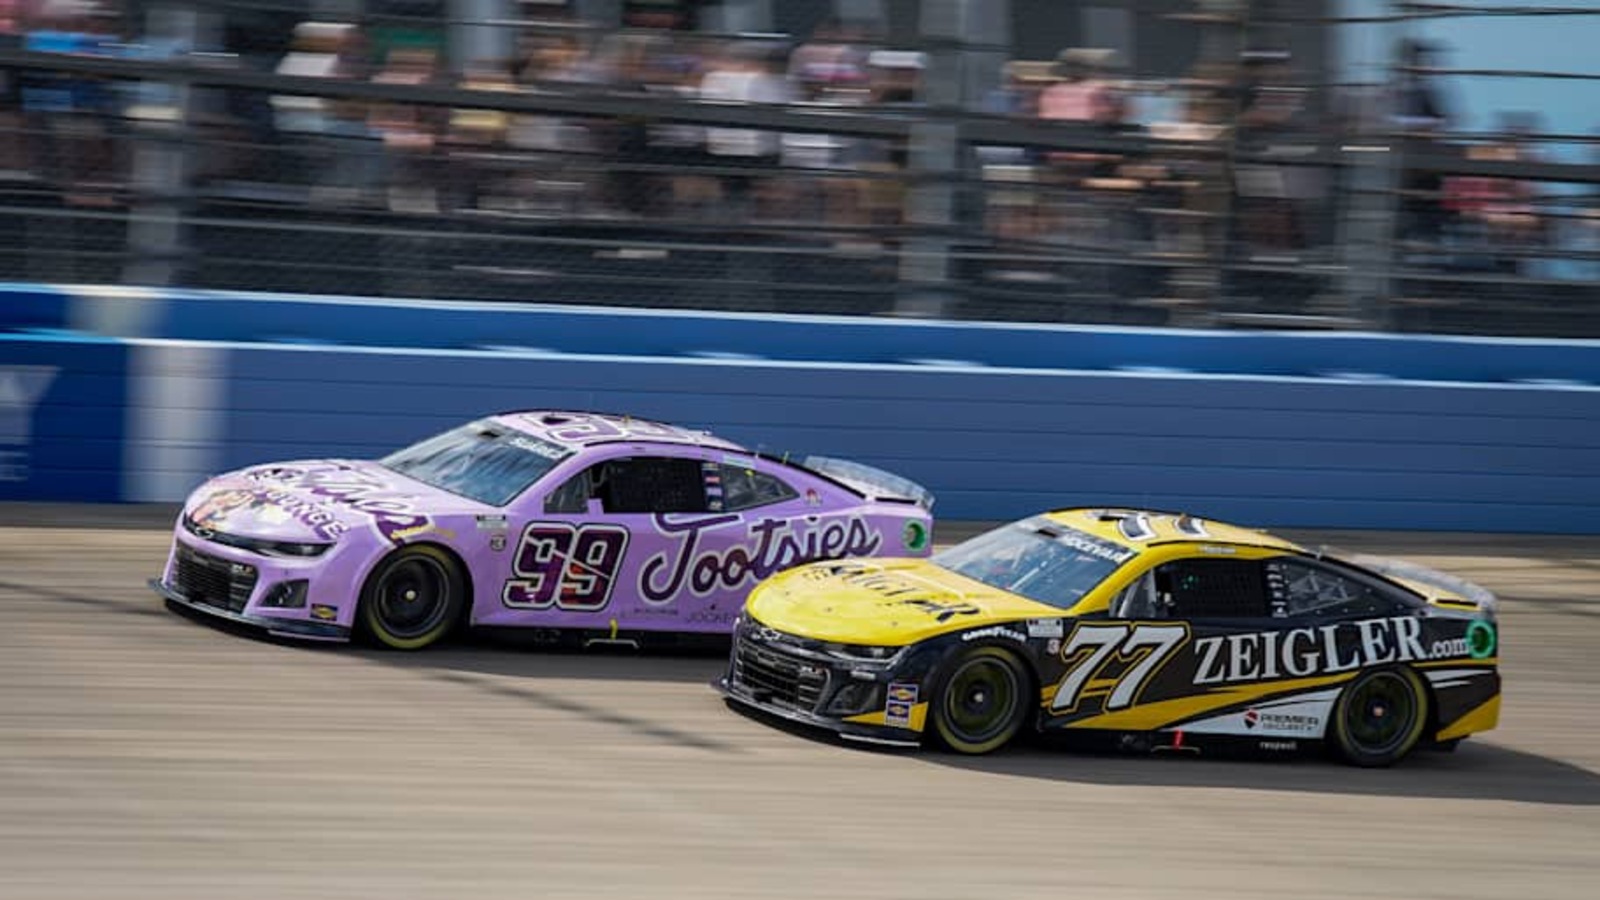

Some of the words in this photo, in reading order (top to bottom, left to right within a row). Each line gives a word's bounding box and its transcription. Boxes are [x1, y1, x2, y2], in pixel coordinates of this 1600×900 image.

[502, 521, 630, 611] 99
[638, 512, 880, 603] Tootsies
[1050, 622, 1190, 714] 77
[1260, 713, 1319, 728] PREMIER
